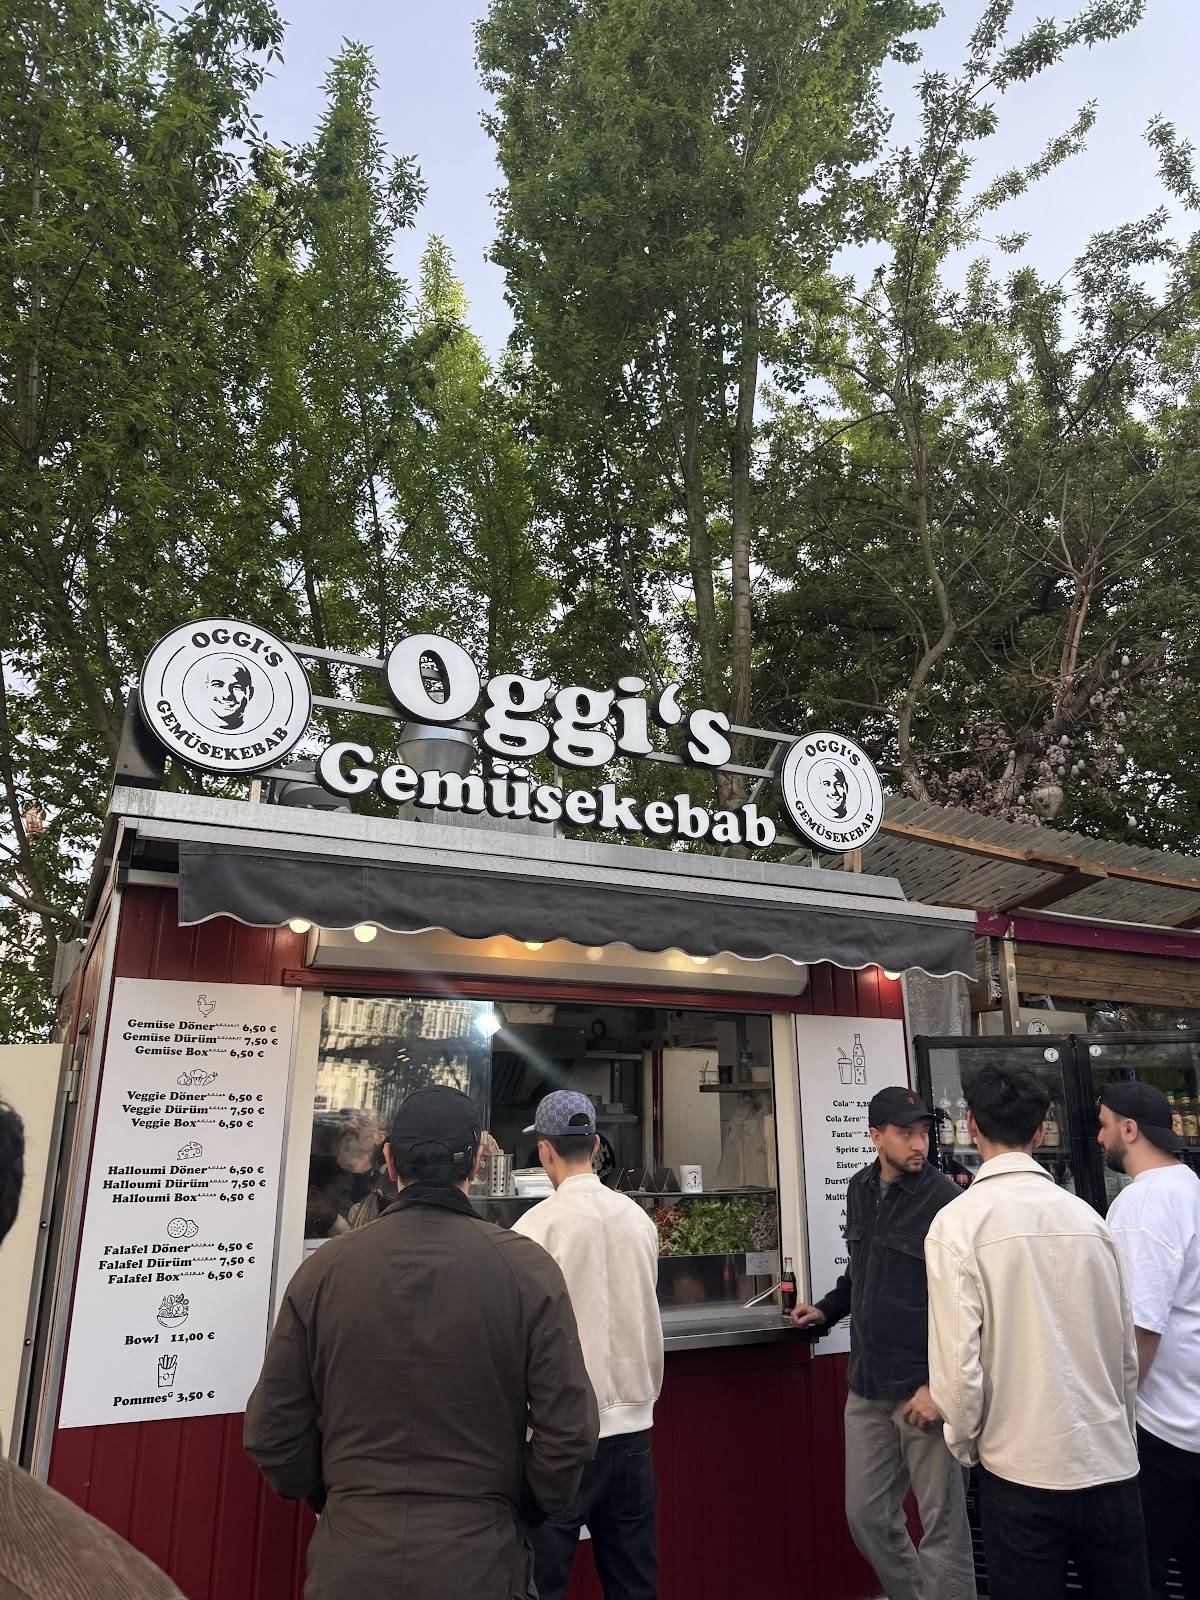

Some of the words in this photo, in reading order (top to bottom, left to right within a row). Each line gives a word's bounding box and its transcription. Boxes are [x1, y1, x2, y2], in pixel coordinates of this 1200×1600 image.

[191, 628, 284, 668] OGGI'S
[384, 633, 732, 767] Oggi's
[156, 699, 288, 761] GEMÜSEKEBAB
[317, 742, 777, 848] Gemüsekebab
[794, 799, 874, 843] GEMÜSEKEBAB
[127, 1019, 175, 1030] Gemüse
[242, 1024, 266, 1034] 6,50
[270, 1025, 277, 1033] €
[122, 1032, 171, 1042] Gemüse
[244, 1037, 268, 1047] 7,50
[135, 1046, 183, 1056] Gemüse
[230, 1049, 254, 1058] 6,50
[257, 1050, 264, 1058] €
[127, 1090, 166, 1101] Veggie
[228, 1093, 252, 1103] 6,50
[122, 1104, 161, 1115] Veggie
[230, 1107, 254, 1116] 7,50
[258, 1107, 265, 1115] €
[131, 1118, 170, 1129] Veggie
[218, 1119, 243, 1129] 6,50
[247, 1120, 254, 1128] €
[832, 1130, 853, 1138] Fanta
[836, 1146, 859, 1154] Sprite
[108, 1165, 166, 1175] Halloumi
[229, 1166, 253, 1176] 6,50
[257, 1166, 264, 1174] €
[103, 1179, 161, 1189] Halloumi
[231, 1180, 255, 1189] 7,50
[112, 1193, 170, 1203] Halloumi
[219, 1193, 244, 1202] 6,50
[248, 1193, 255, 1201] €
[104, 1245, 148, 1255] Falafel
[217, 1243, 242, 1252] 6,50
[98, 1259, 143, 1270] Falafel
[219, 1257, 244, 1267] 7,50
[248, 1256, 255, 1264] €
[108, 1273, 151, 1284] Falafel
[207, 1271, 232, 1281] 6,50
[124, 1334, 159, 1345] Bowl
[170, 1332, 203, 1344] 11,00
[207, 1332, 215, 1340] €
[176, 1391, 203, 1403] 3,50
[207, 1390, 215, 1399] €
